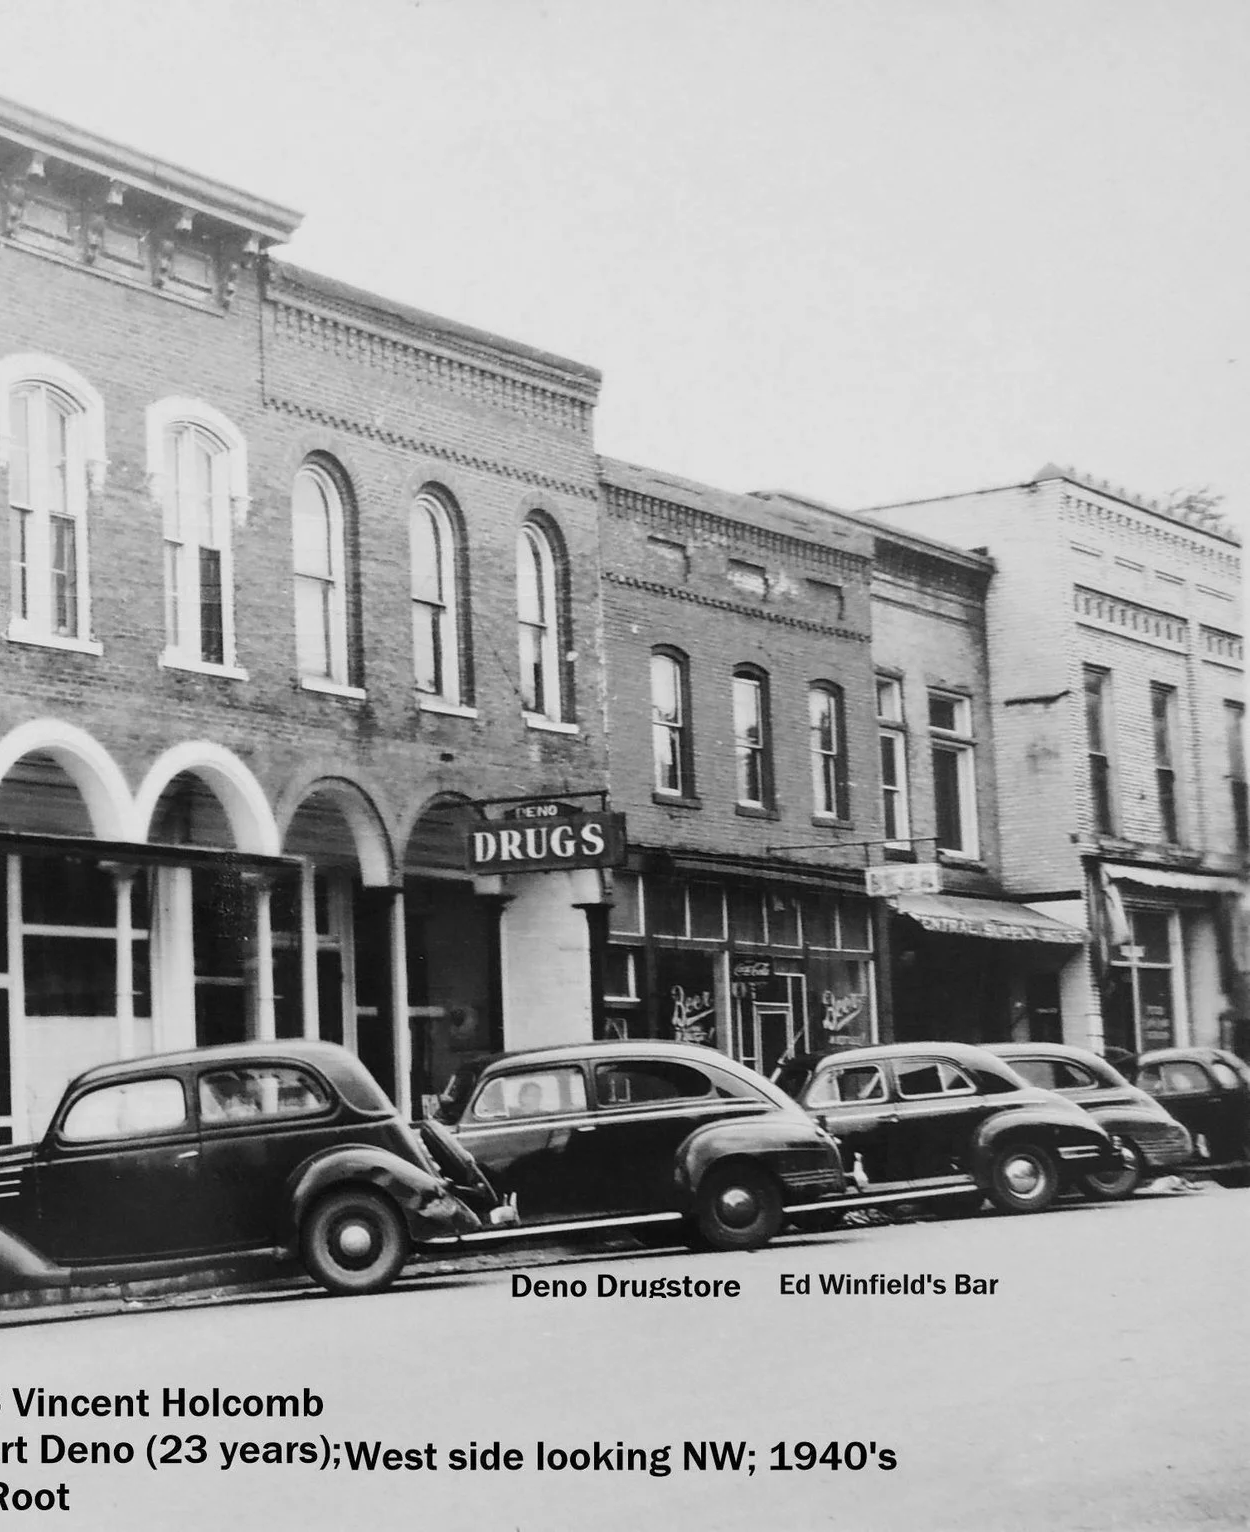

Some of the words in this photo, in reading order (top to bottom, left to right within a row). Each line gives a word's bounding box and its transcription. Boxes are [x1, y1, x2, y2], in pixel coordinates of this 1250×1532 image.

[515, 804, 559, 819] DENO
[472, 822, 606, 863] DRUGS
[670, 984, 714, 1027] Beer
